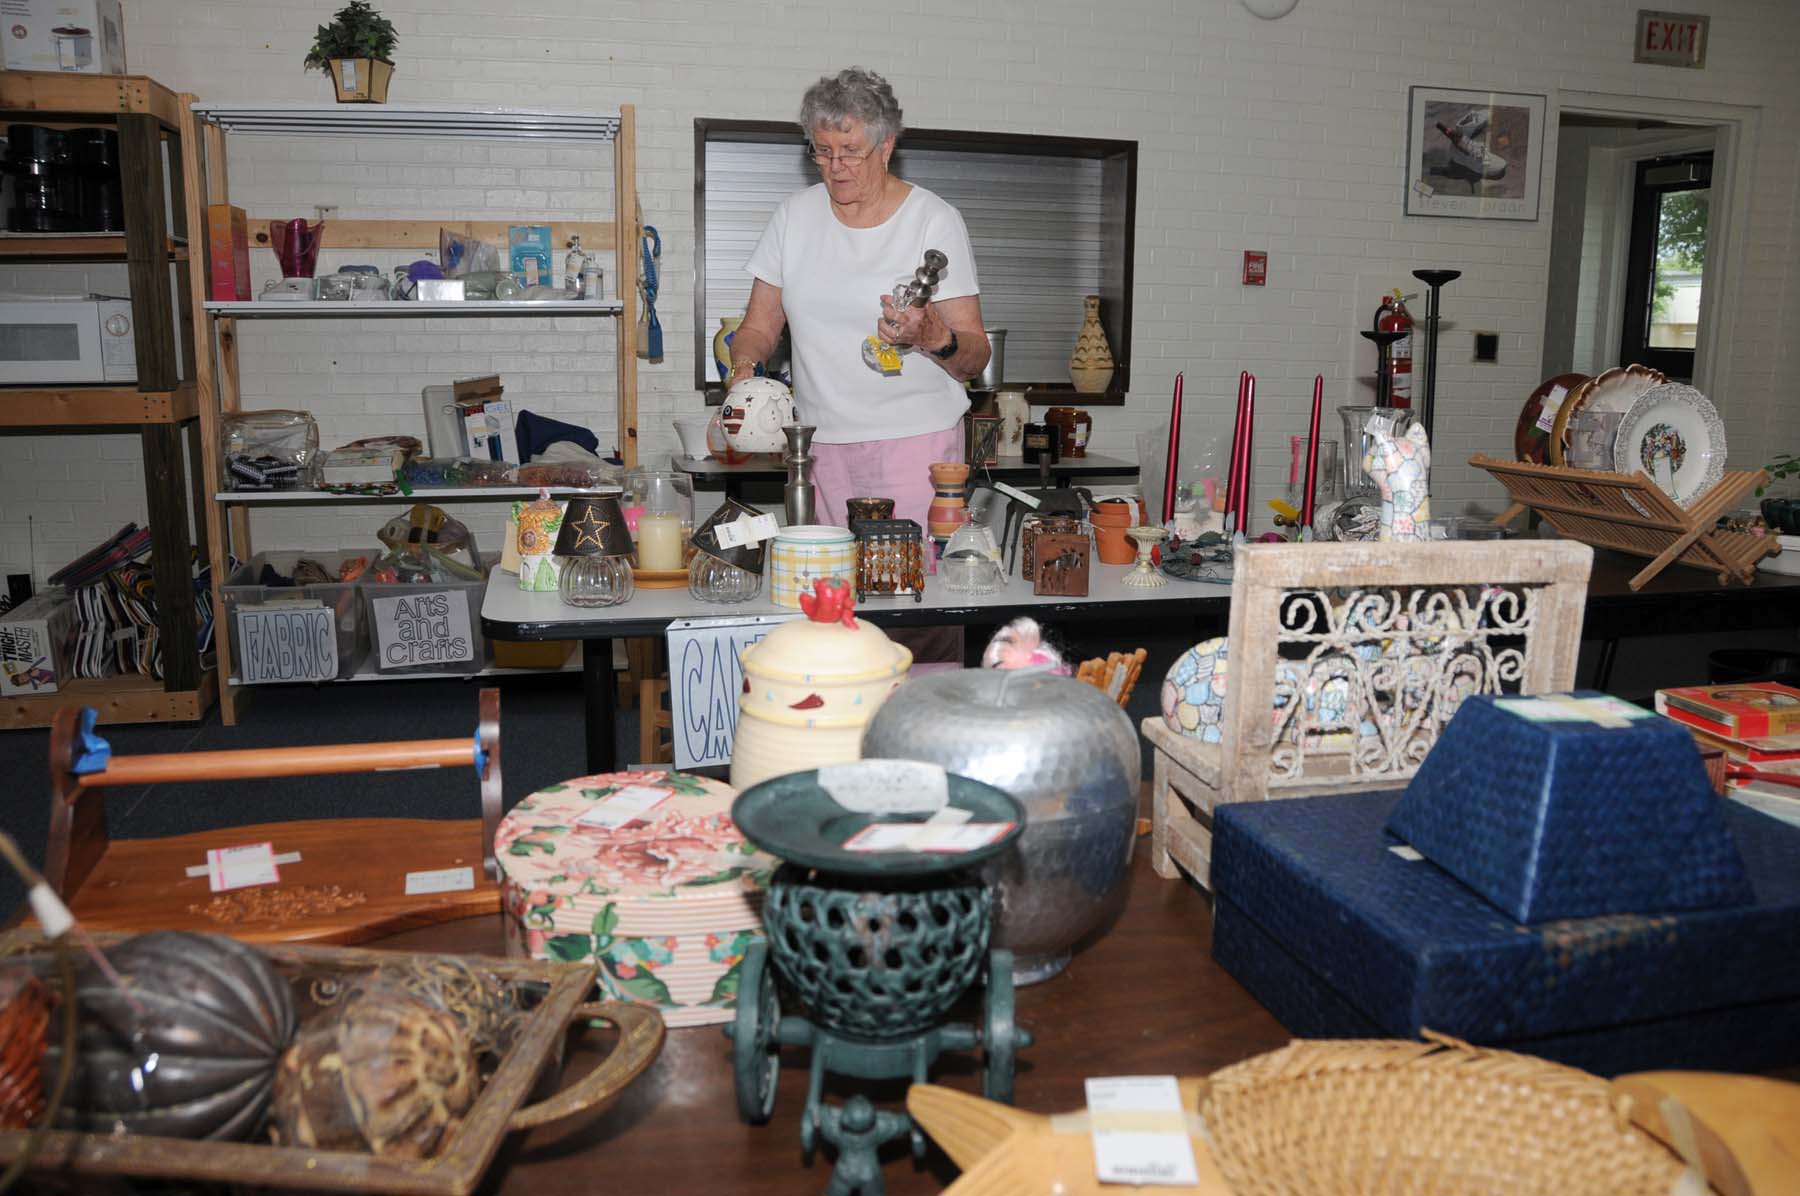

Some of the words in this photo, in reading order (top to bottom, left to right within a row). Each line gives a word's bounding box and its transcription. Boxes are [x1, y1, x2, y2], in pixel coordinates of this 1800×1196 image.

[1647, 20, 1697, 52] EXIT
[393, 594, 449, 620] Arts
[398, 615, 450, 641] and
[14, 626, 33, 663] MASTER
[243, 612, 333, 681] FABRIC
